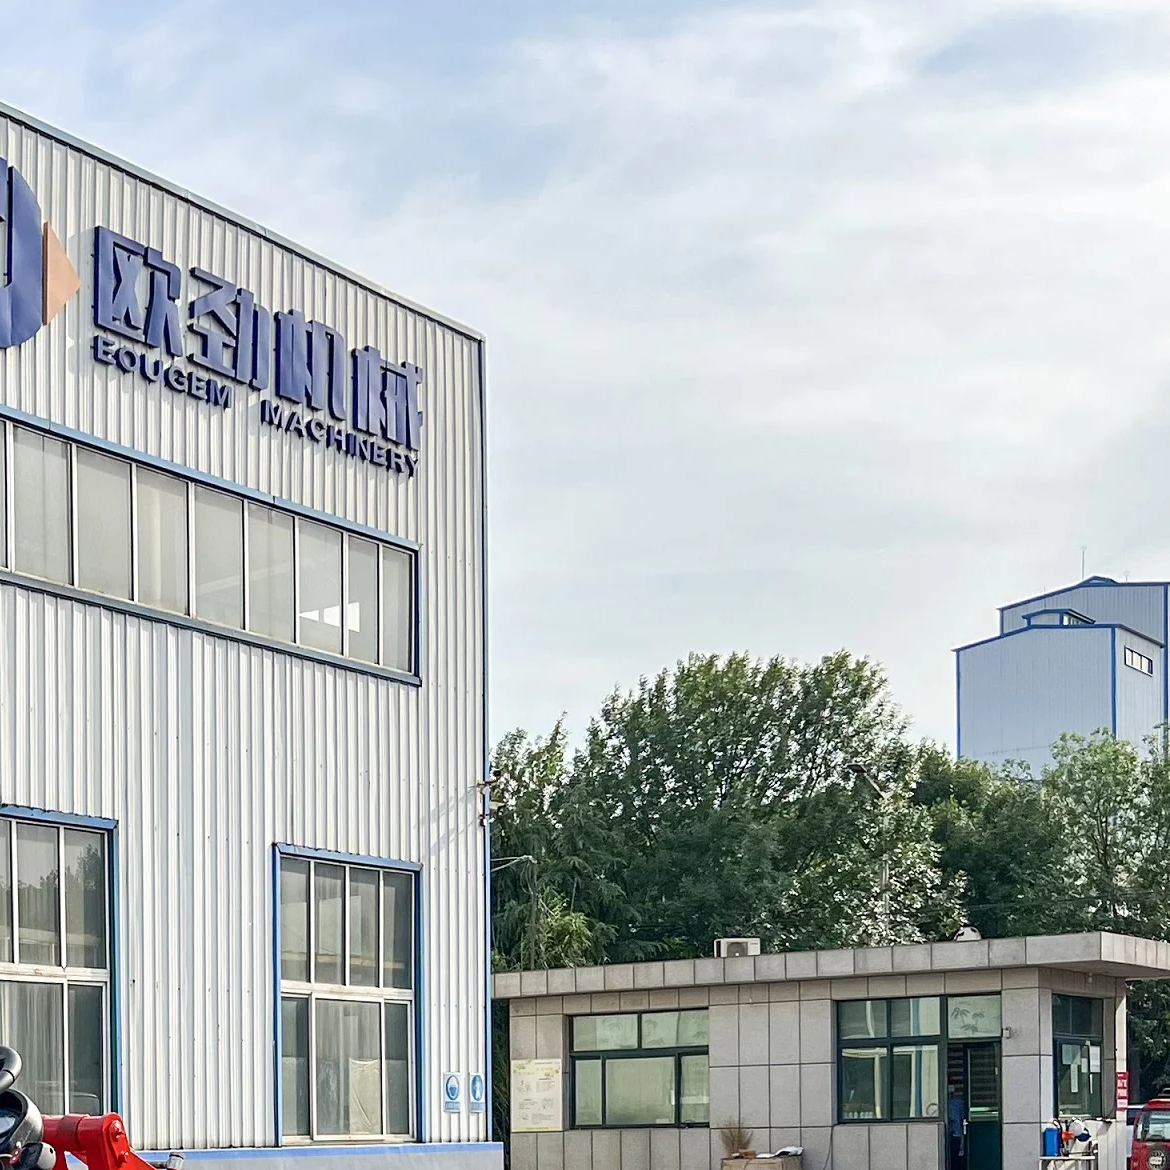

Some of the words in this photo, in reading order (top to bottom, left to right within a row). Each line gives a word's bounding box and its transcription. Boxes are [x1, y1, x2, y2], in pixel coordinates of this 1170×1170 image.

[93, 226, 424, 451] 欧劲机械
[93, 335, 232, 409] EOUGEM
[260, 399, 420, 477] MACHINERY
